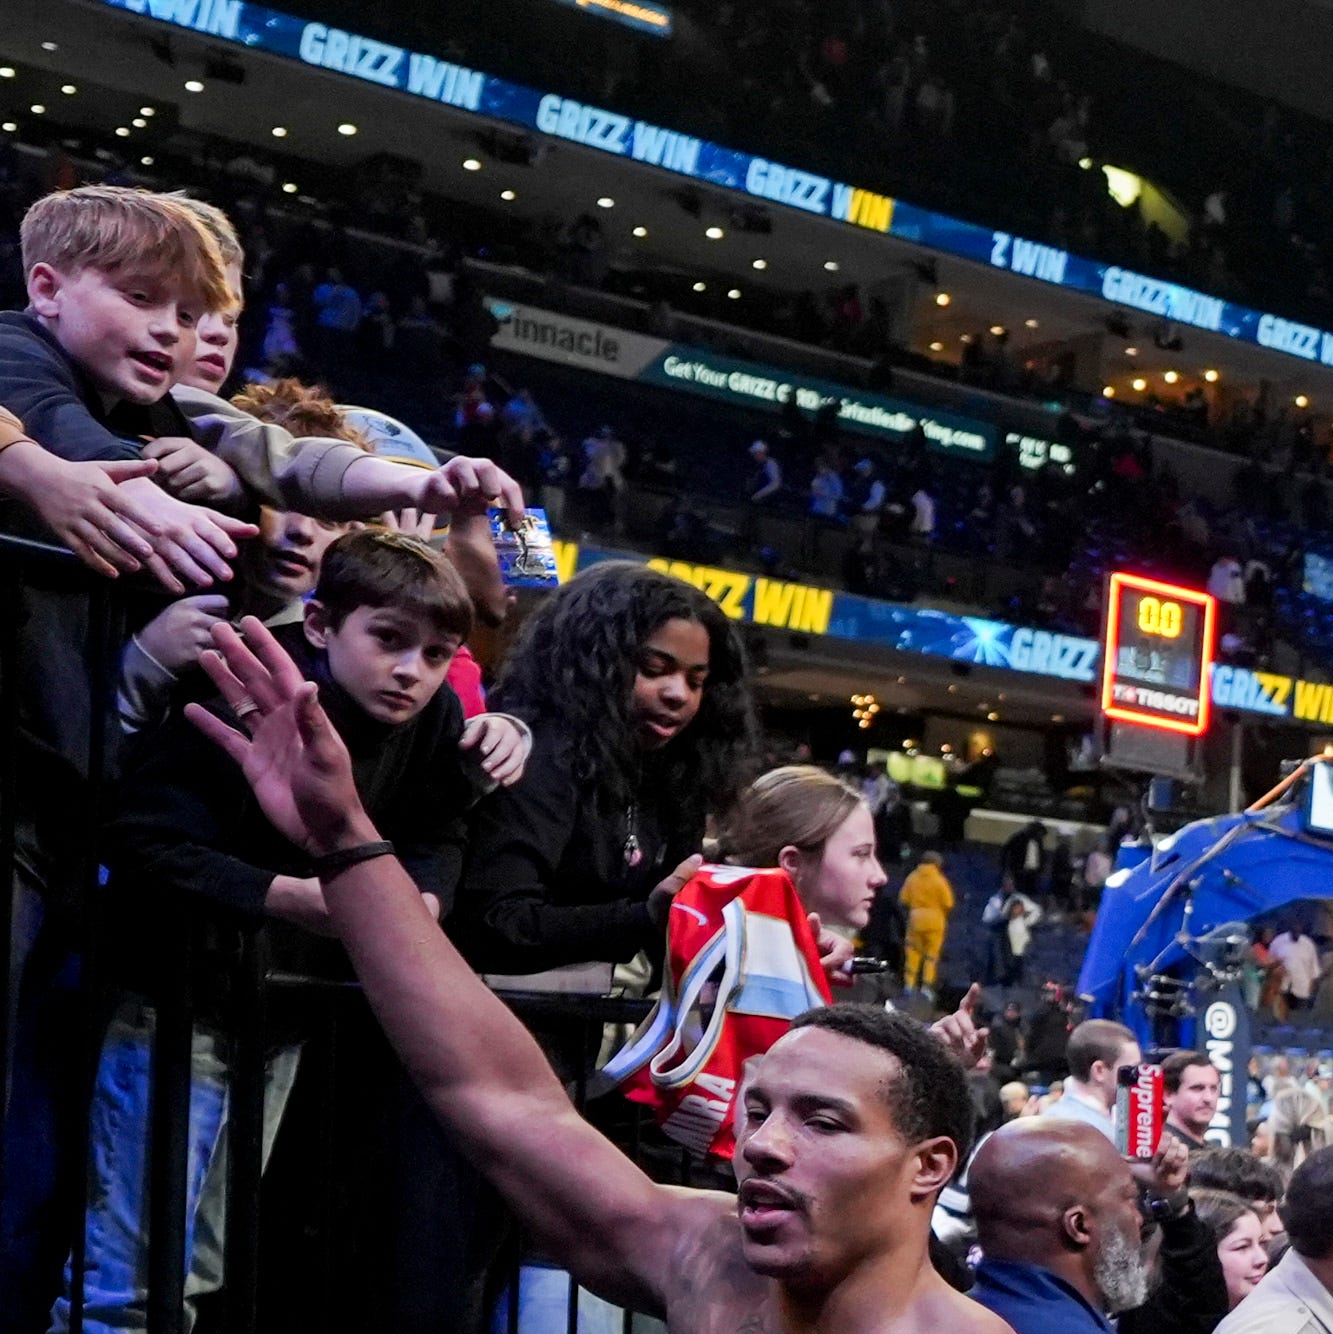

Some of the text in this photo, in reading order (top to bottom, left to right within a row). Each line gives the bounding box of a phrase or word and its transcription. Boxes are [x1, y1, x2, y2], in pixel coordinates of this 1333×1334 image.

[300, 22, 486, 112] GRIZZ WIN
[536, 93, 702, 176] GRIZZ WIN
[746, 156, 894, 233] GRIZZ WIN
[1010, 236, 1068, 284] WIN
[499, 312, 620, 362] innacle
[1256, 313, 1321, 362] GRIZZ
[752, 577, 835, 634] WIN
[1010, 627, 1100, 682] GRIZZ
[1136, 687, 1199, 716] TISSOT
[1210, 663, 1292, 717] GRIZZ
[1131, 1063, 1161, 1158] Supreme
